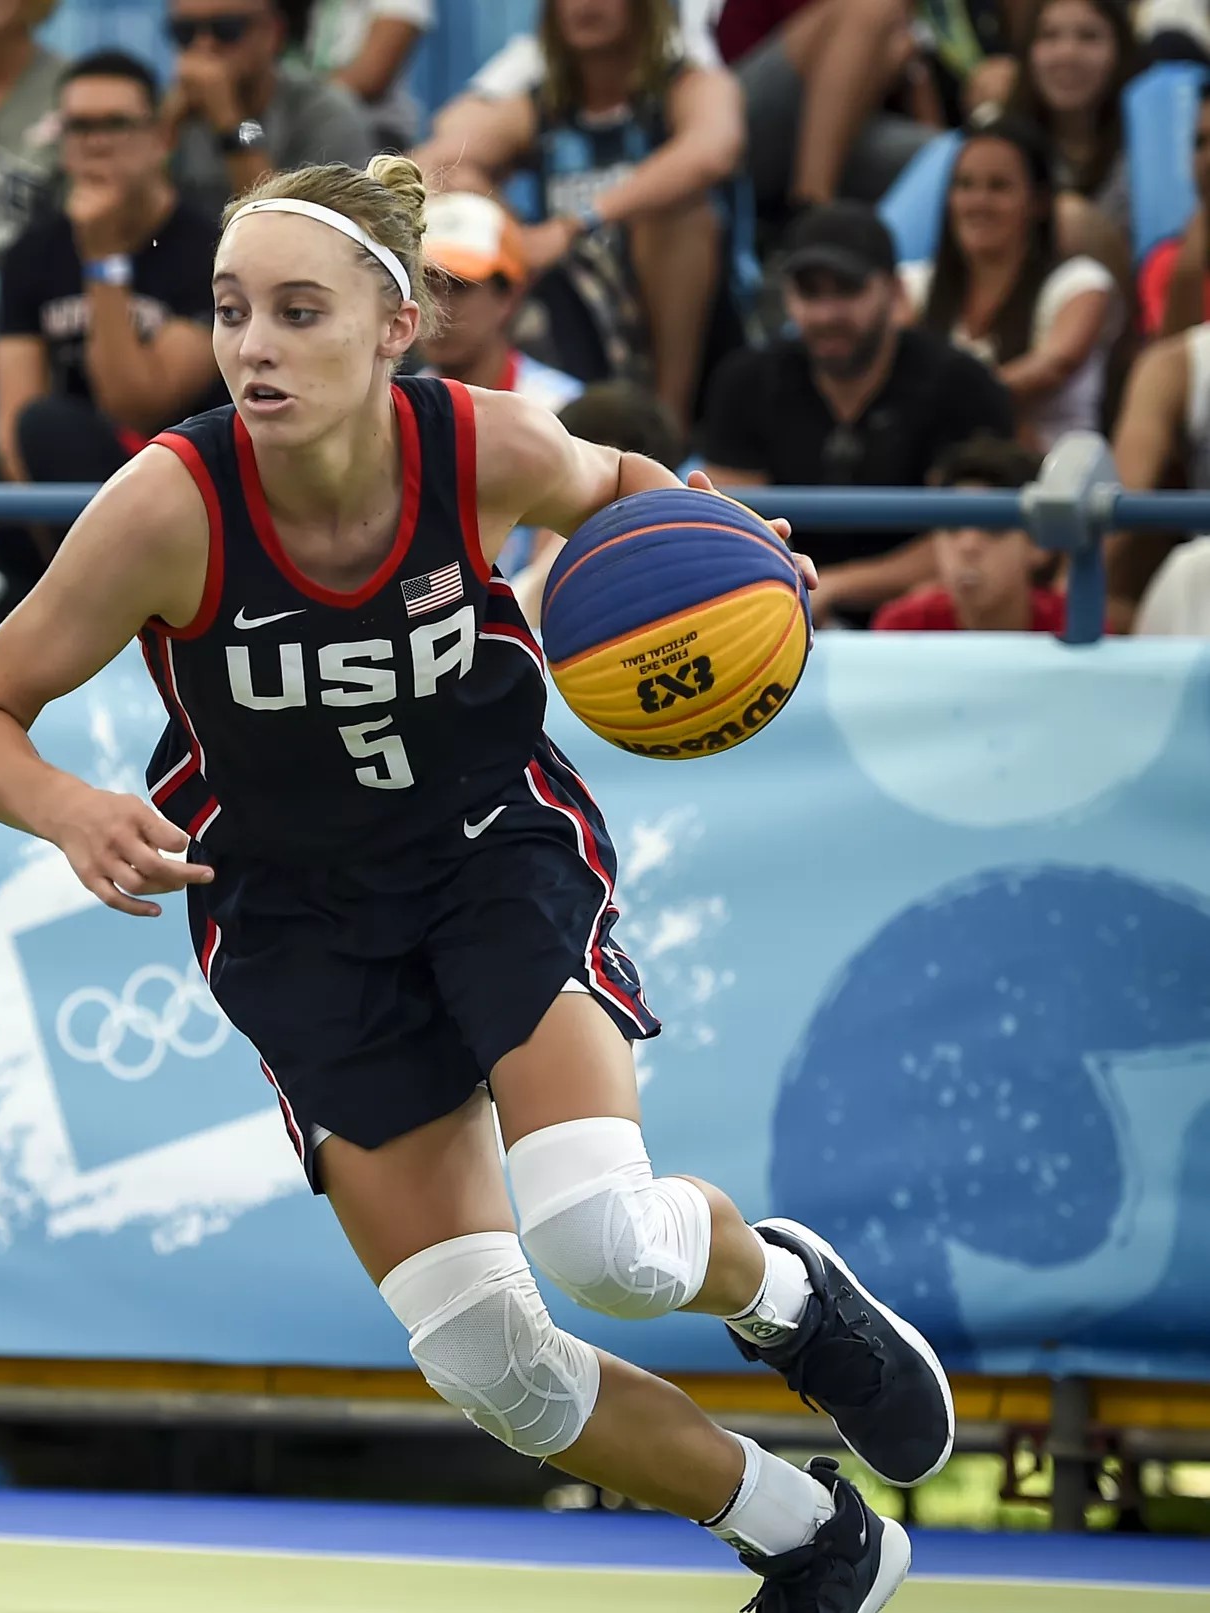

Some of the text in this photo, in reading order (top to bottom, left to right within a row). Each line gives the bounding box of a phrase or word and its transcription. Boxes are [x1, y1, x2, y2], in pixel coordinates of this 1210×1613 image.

[225, 605, 476, 711] USA
[620, 630, 698, 669] OFFICIAL BALL
[662, 647, 689, 667] FIBA
[338, 714, 414, 789] 5
